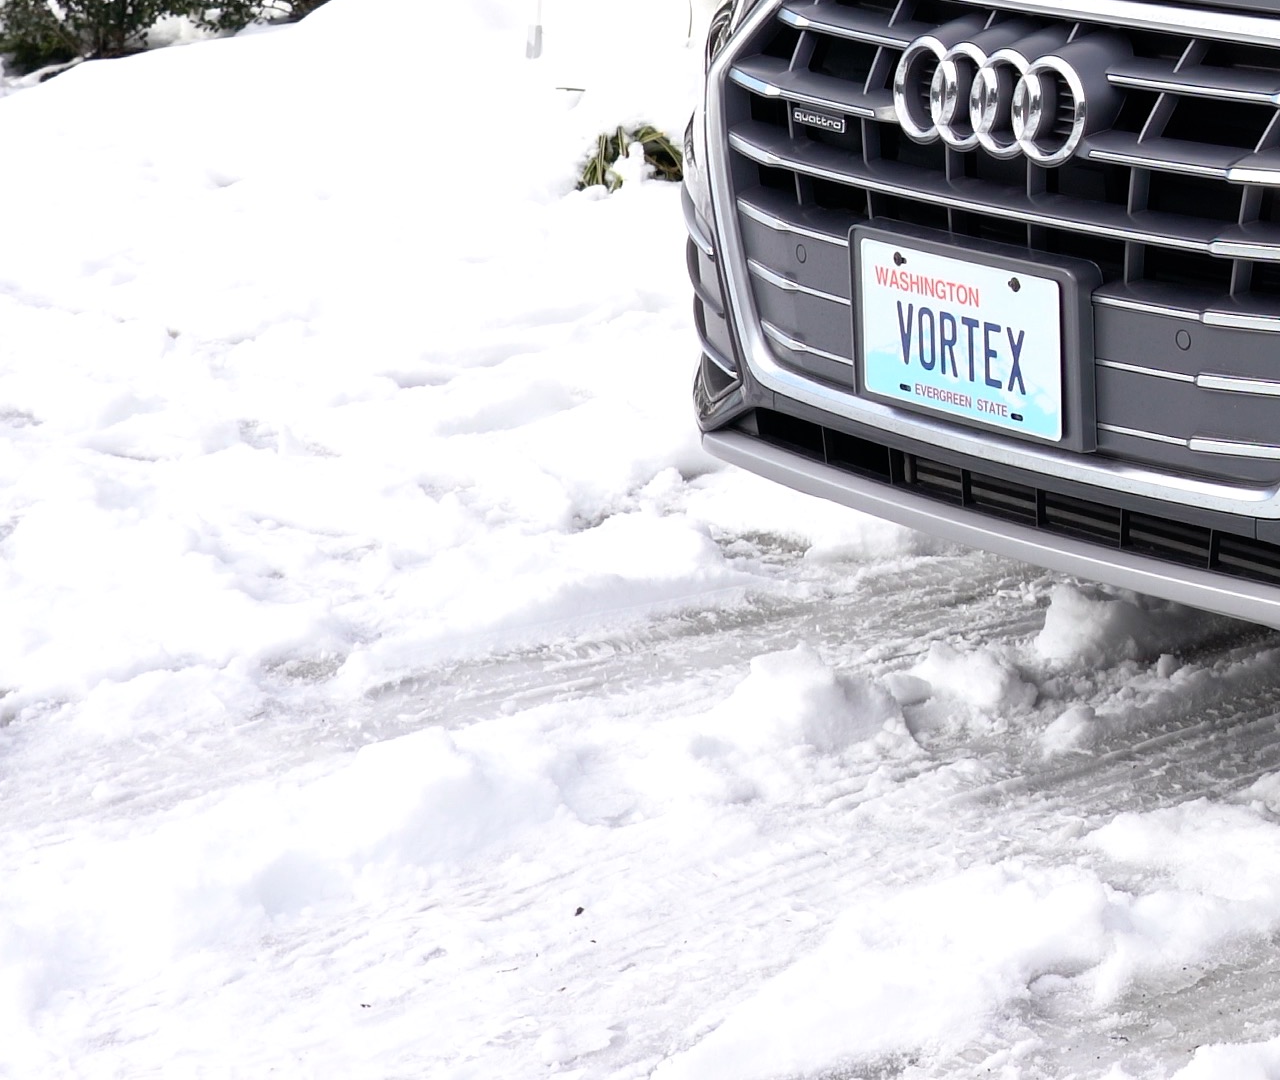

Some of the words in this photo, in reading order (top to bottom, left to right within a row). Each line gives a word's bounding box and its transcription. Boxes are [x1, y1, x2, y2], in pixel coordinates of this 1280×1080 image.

[794, 110, 842, 129] quattro
[874, 264, 980, 308] WASHINGTON
[896, 300, 1027, 396] VORTEX
[914, 383, 973, 409] EVERGREEN
[976, 398, 1009, 418] STATE
